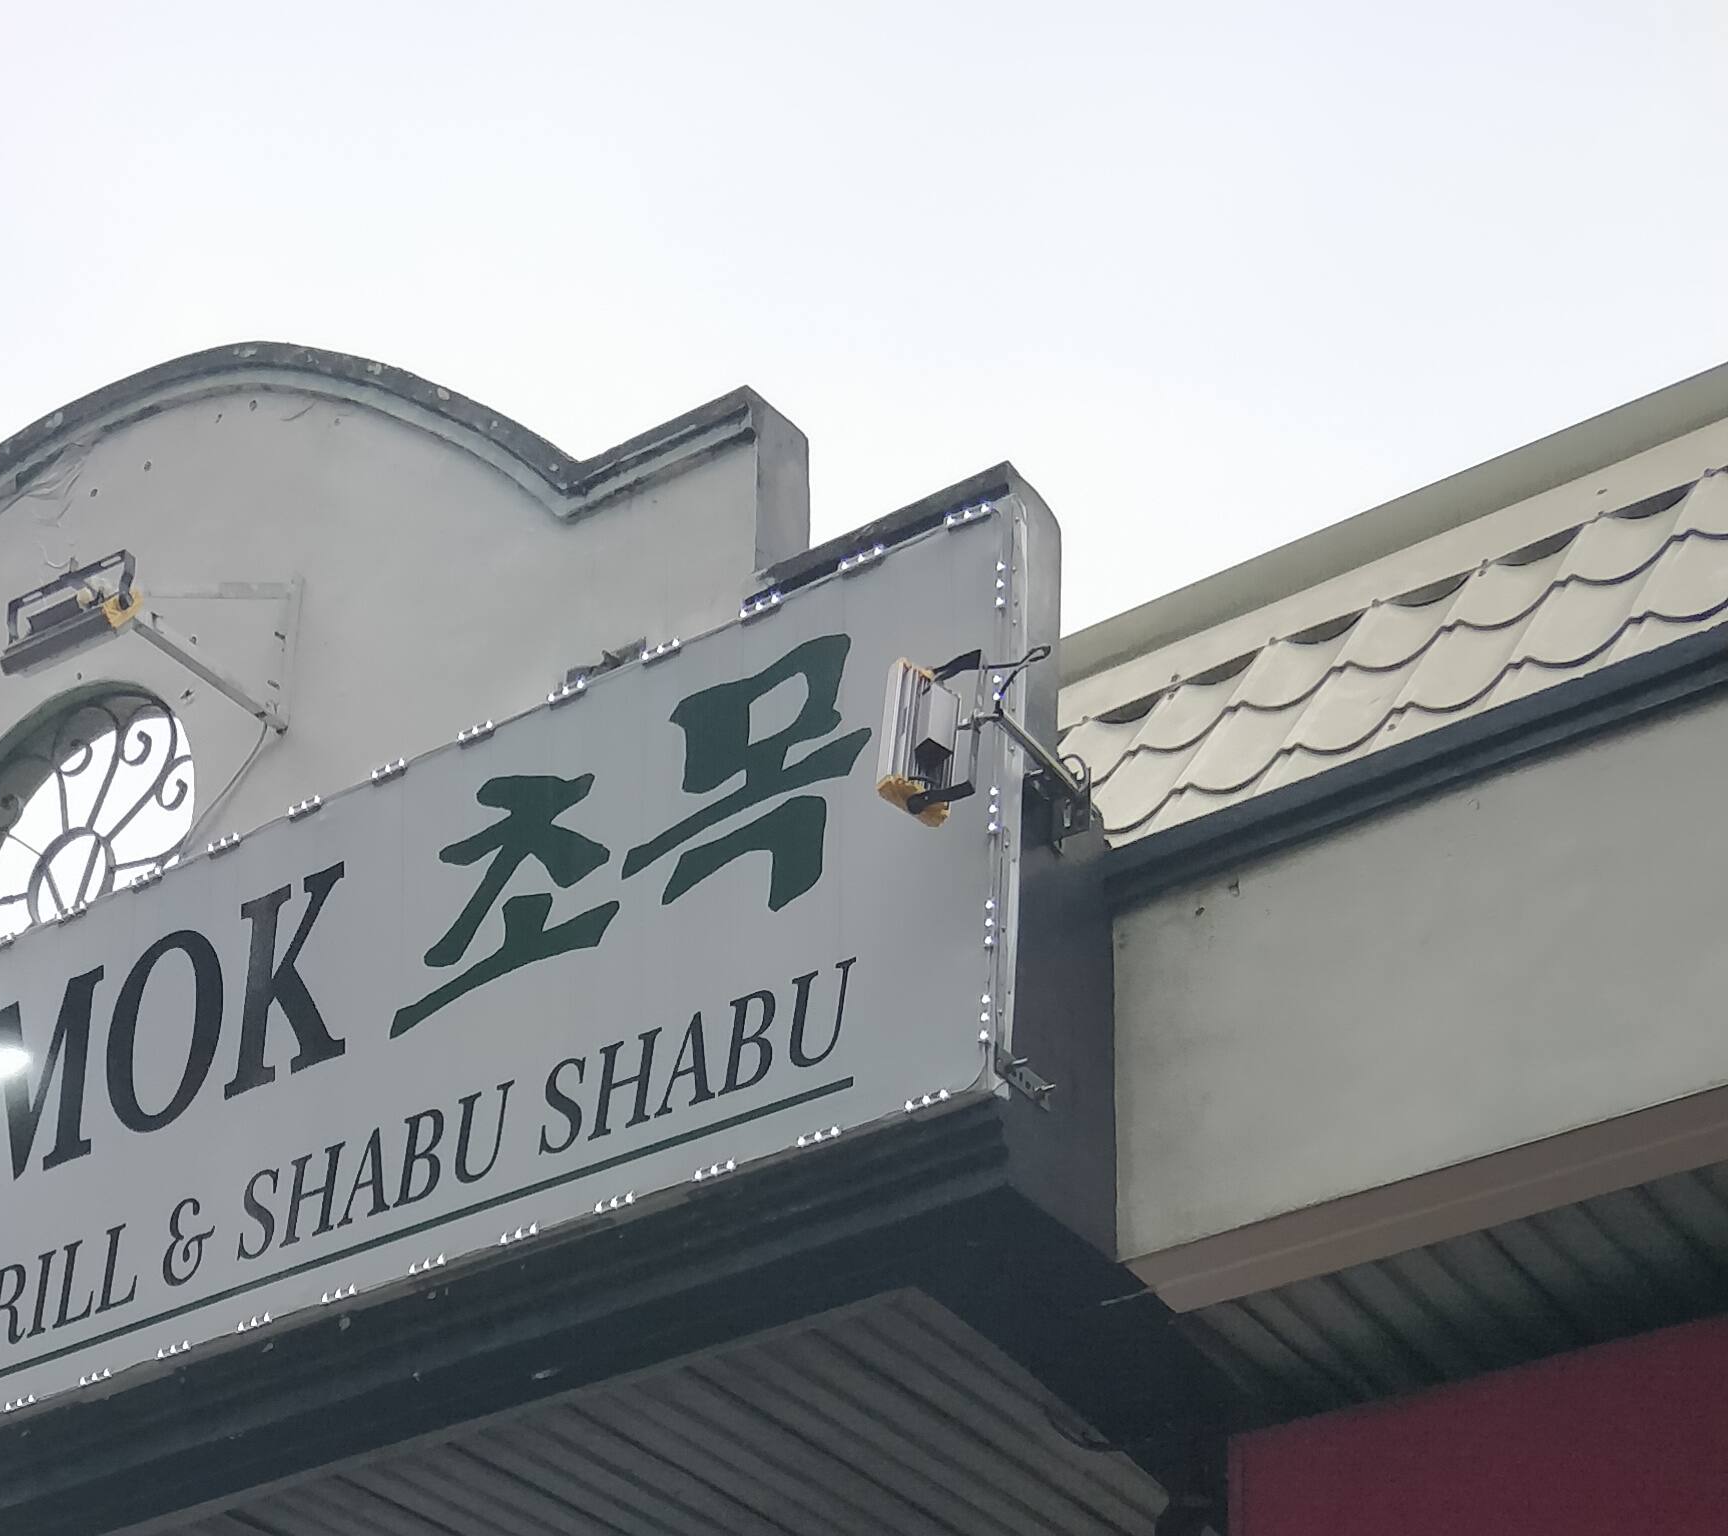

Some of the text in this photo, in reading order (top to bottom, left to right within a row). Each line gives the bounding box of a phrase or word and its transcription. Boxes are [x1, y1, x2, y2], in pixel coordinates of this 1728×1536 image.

[389, 633, 872, 1040] 초목
[162, 1197, 216, 1288] &
[235, 1081, 516, 1261] SHABU
[537, 957, 858, 1156] SHABU
